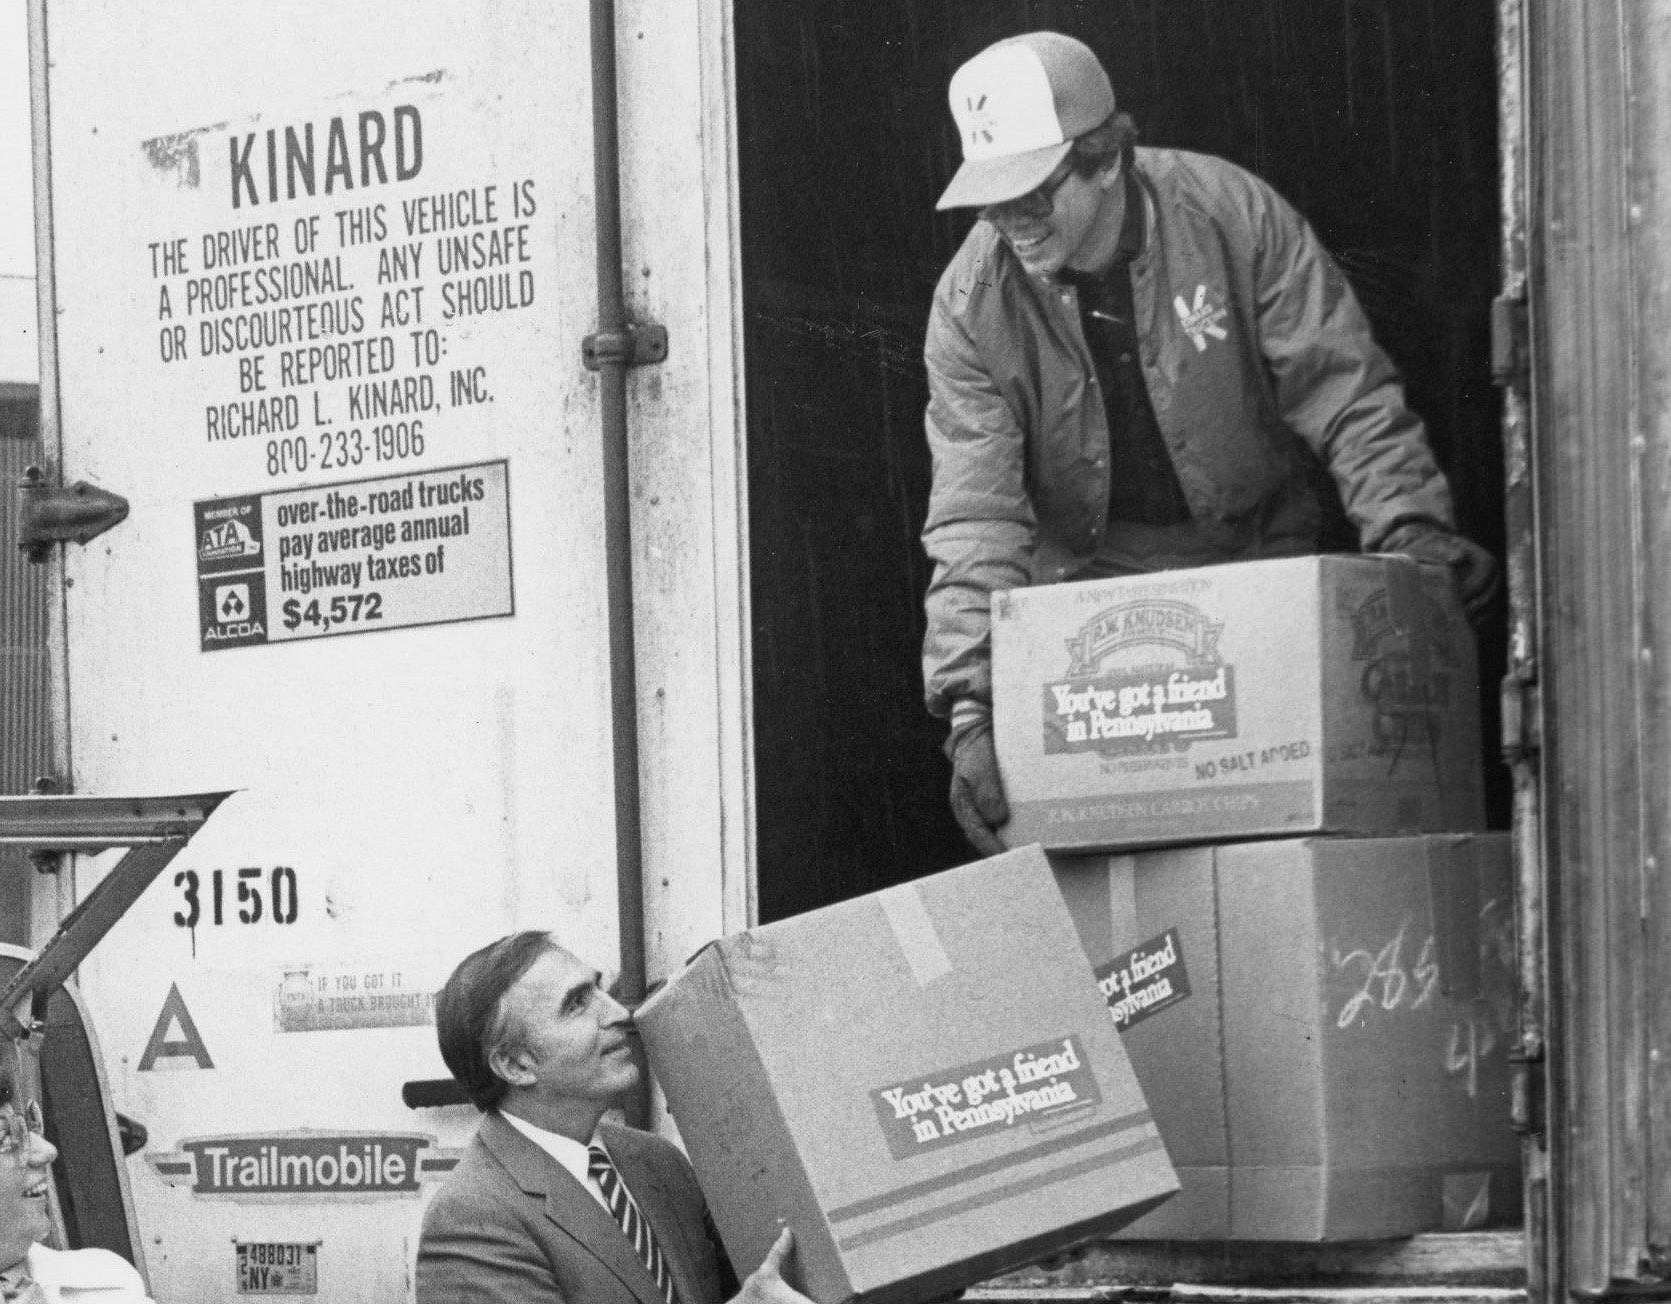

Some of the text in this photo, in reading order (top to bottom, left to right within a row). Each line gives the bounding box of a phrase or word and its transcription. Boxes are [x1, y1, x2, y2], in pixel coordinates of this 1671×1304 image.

[229, 104, 424, 210] KINARD
[148, 179, 537, 279] THE DRIVER OF THIS VEHICLE IS
[158, 225, 531, 320] A PROFESSIONAL. ANY UNSAFE
[159, 269, 535, 363] OR DISCOURTEOUS ACT SHOULD
[239, 329, 448, 394] BE REPORTED TO:
[205, 365, 495, 442] RICHARD L. KINARD, INC.
[265, 420, 425, 477] 800-233-1906
[240, 505, 252, 515] OF
[276, 474, 485, 527] over-the-road trucks
[203, 521, 240, 550] ATA
[279, 506, 471, 563] pay average annual
[279, 544, 446, 595] highway taxes of
[204, 621, 264, 641] ALCOA
[282, 592, 384, 633] $4,572
[1052, 684, 1116, 715] You've
[1118, 682, 1151, 716] got
[1153, 684, 1166, 704] a
[1167, 667, 1227, 704] friend
[1065, 702, 1215, 742] in Pennsylvania
[1194, 760, 1217, 780] NO
[1220, 751, 1255, 774] SALT
[173, 866, 299, 928] 3150
[335, 975, 356, 990] YOU
[391, 972, 402, 988] IT
[1131, 934, 1176, 983] friend
[137, 980, 216, 1072] A
[329, 996, 365, 1012] TRUCK
[370, 993, 420, 1011] BROUGHT
[881, 1039, 1080, 1119] You've got a friend
[910, 1076, 1077, 1143] in Pennsylvania
[205, 1144, 407, 1187] Trailmobile
[249, 1267, 269, 1290] NY
